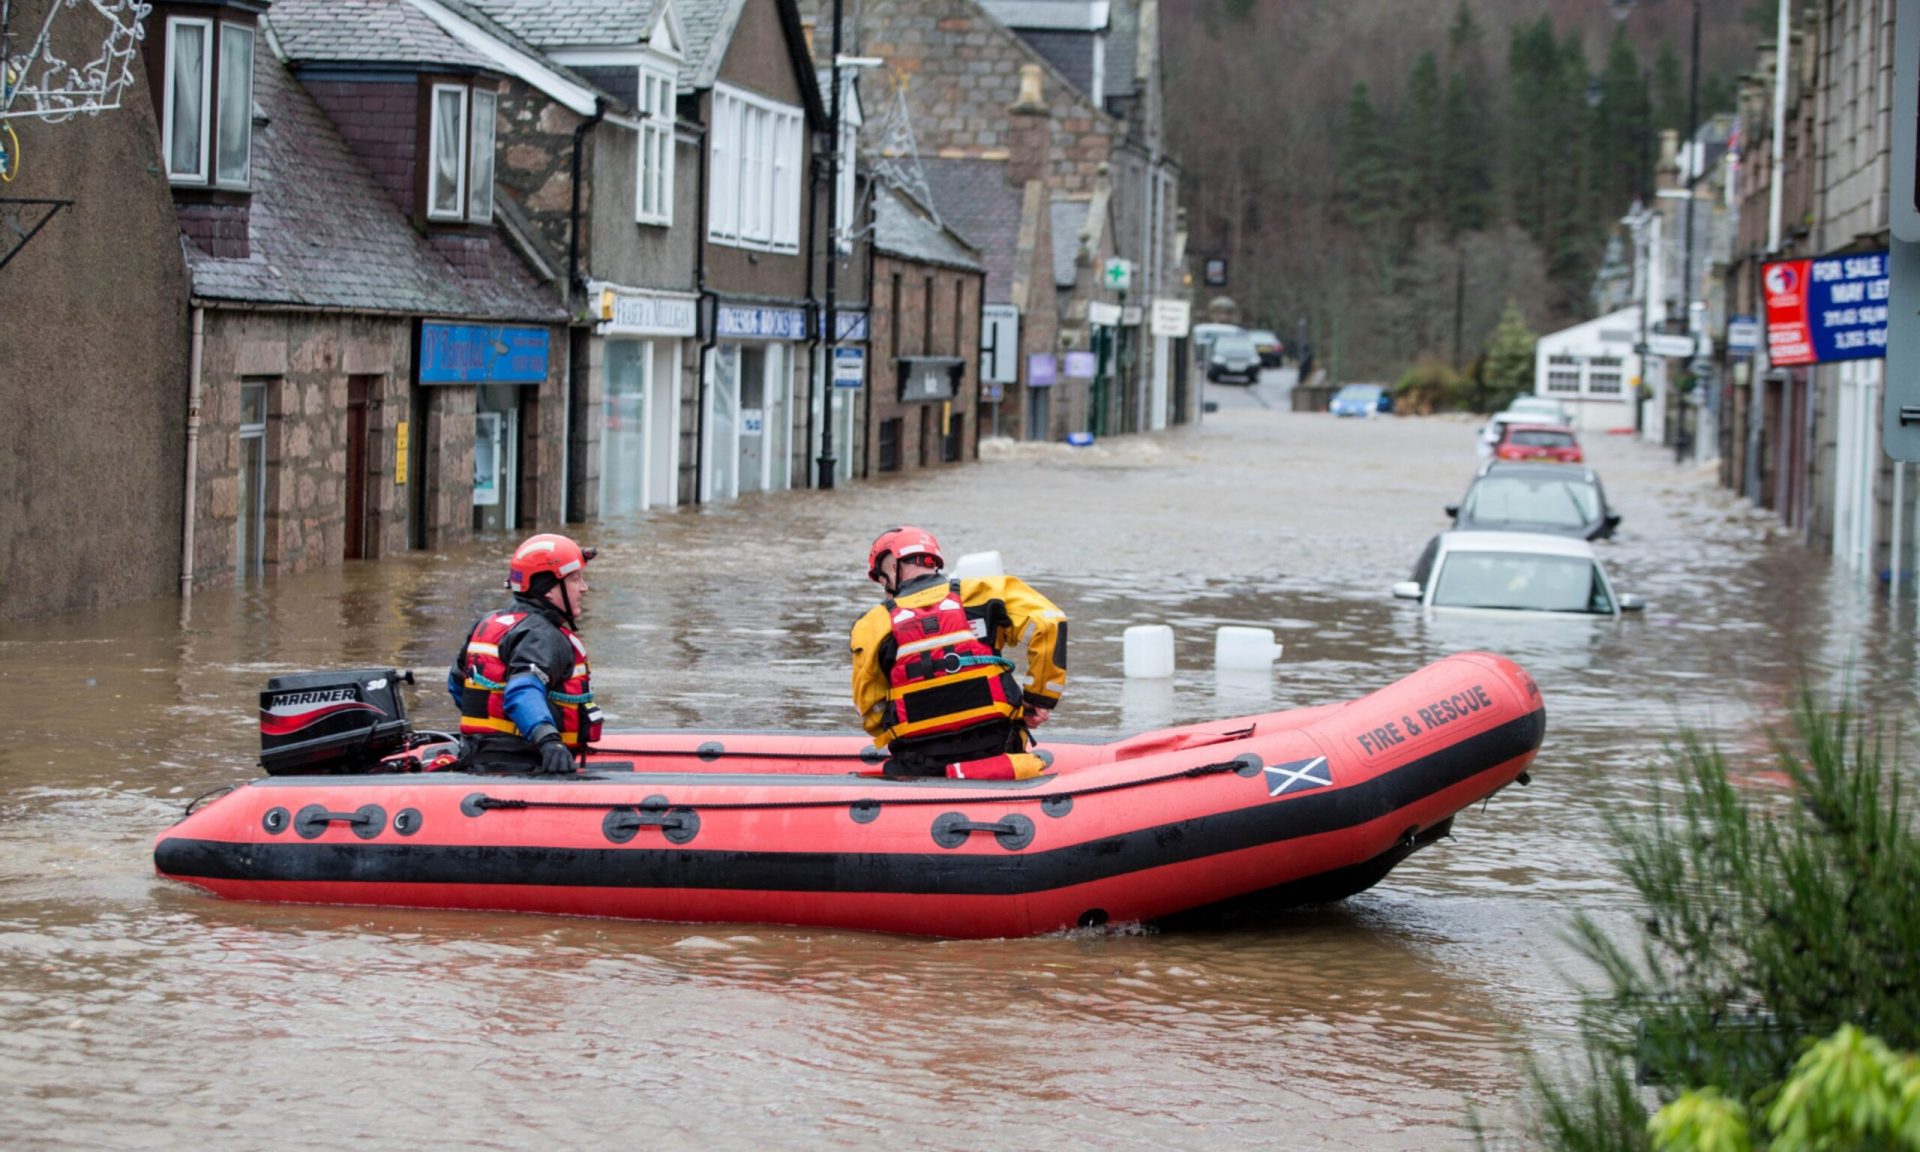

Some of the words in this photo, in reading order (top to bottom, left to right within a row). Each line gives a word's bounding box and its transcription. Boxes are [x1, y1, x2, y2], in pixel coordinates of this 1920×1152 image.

[1812, 260, 1843, 282] FOR
[1845, 256, 1881, 279] SALE
[1830, 281, 1865, 304] MAY
[272, 688, 357, 708] MARINER
[1357, 722, 1406, 756] FIRE
[1402, 716, 1422, 737] &
[1416, 685, 1493, 731] RESCUE
